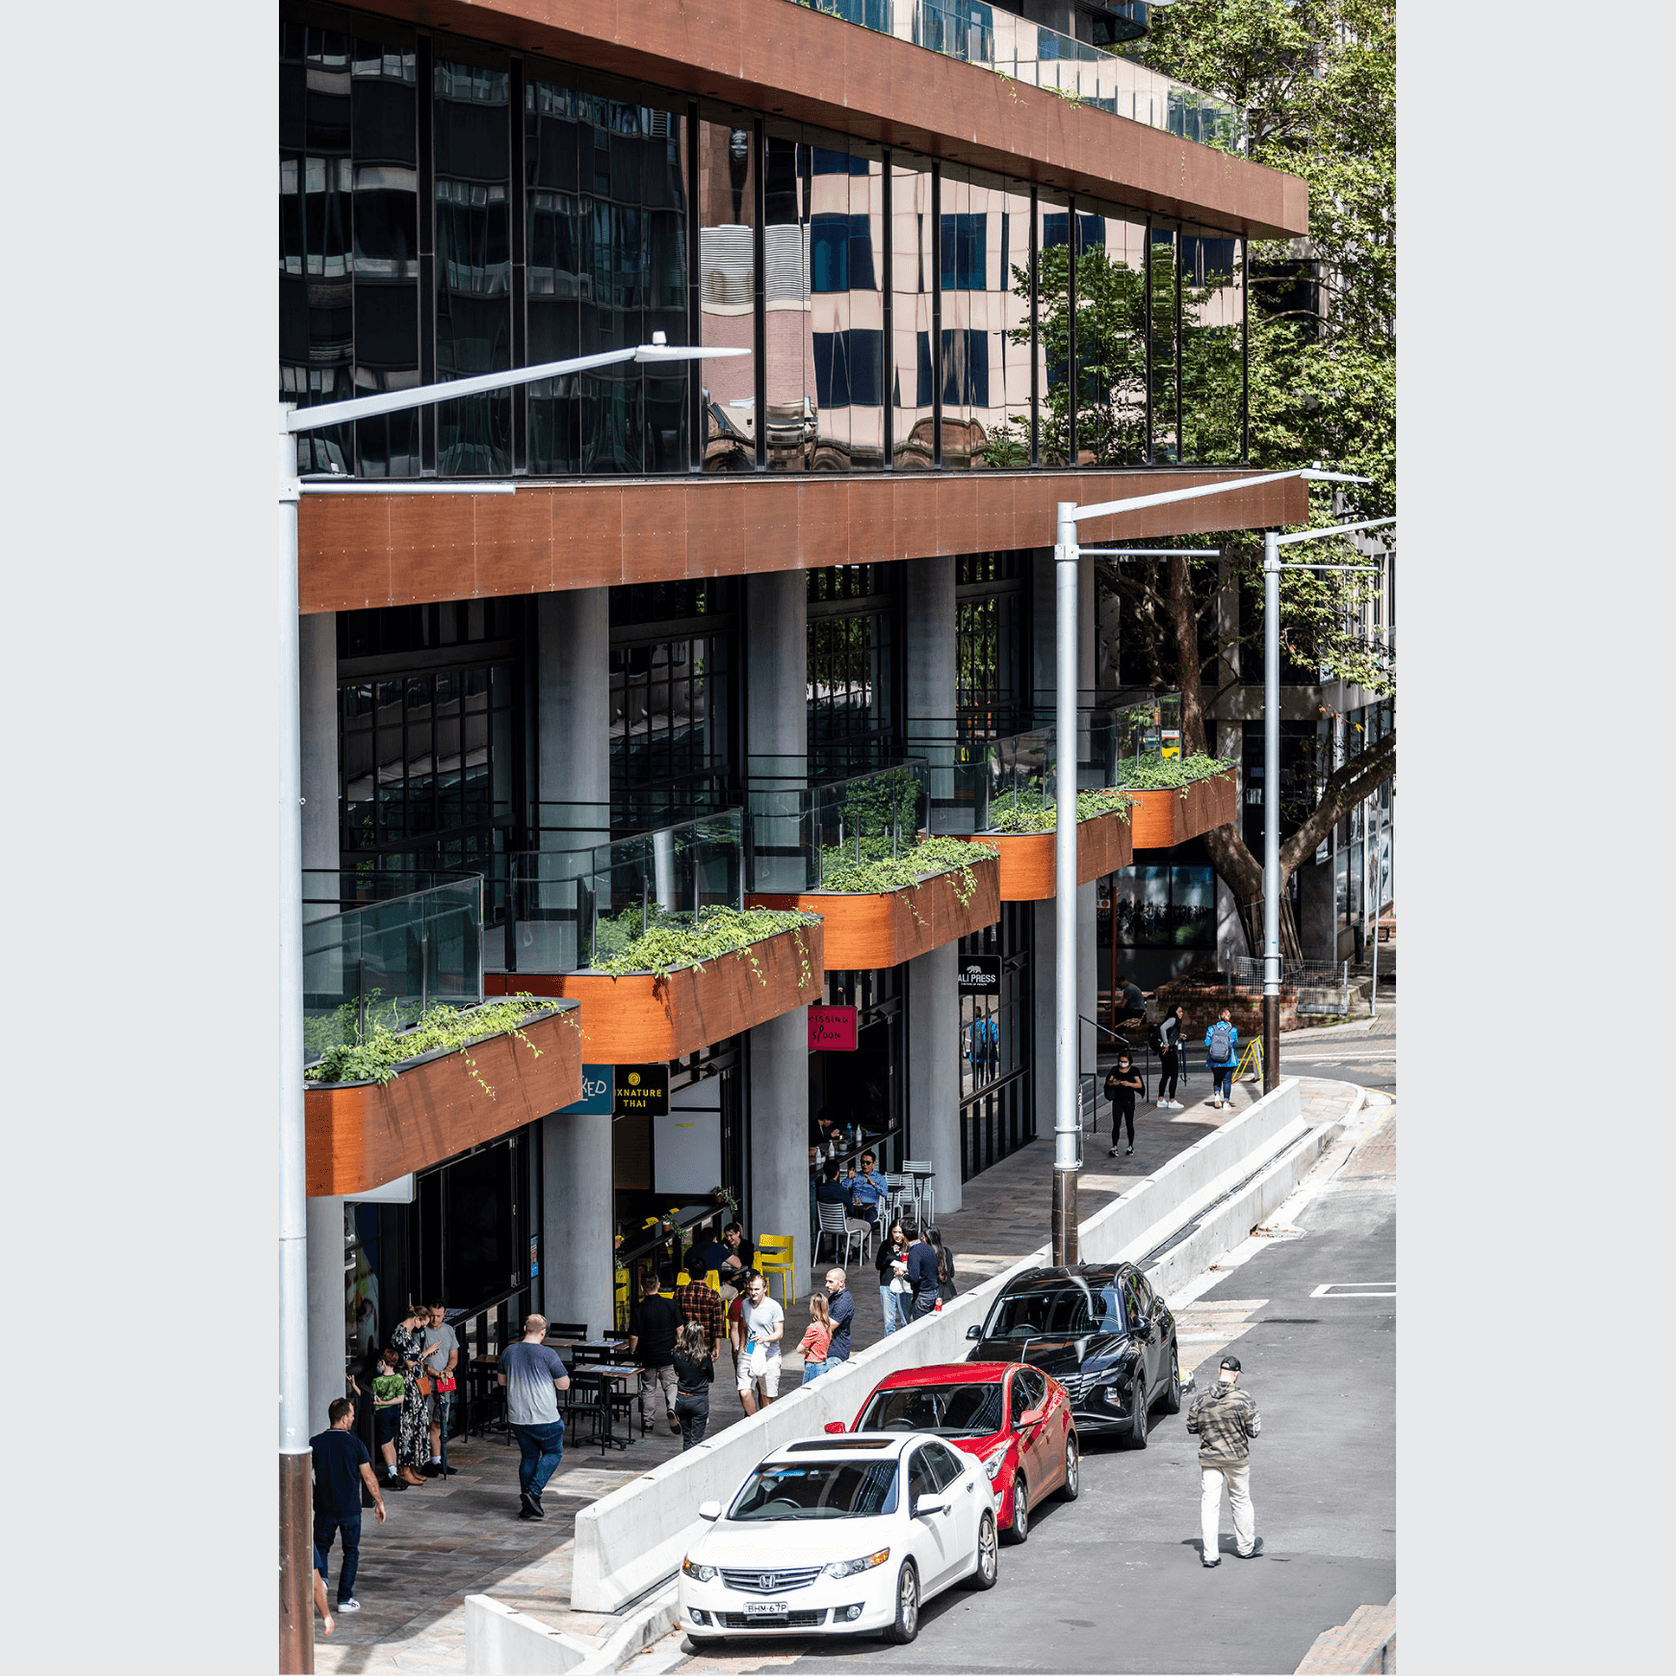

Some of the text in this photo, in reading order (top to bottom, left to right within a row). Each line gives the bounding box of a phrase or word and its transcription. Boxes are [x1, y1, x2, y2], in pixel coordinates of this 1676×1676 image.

[970, 974, 996, 983] PRESS
[615, 1089, 662, 1097] XNATURE
[623, 1099, 646, 1107] THAI
